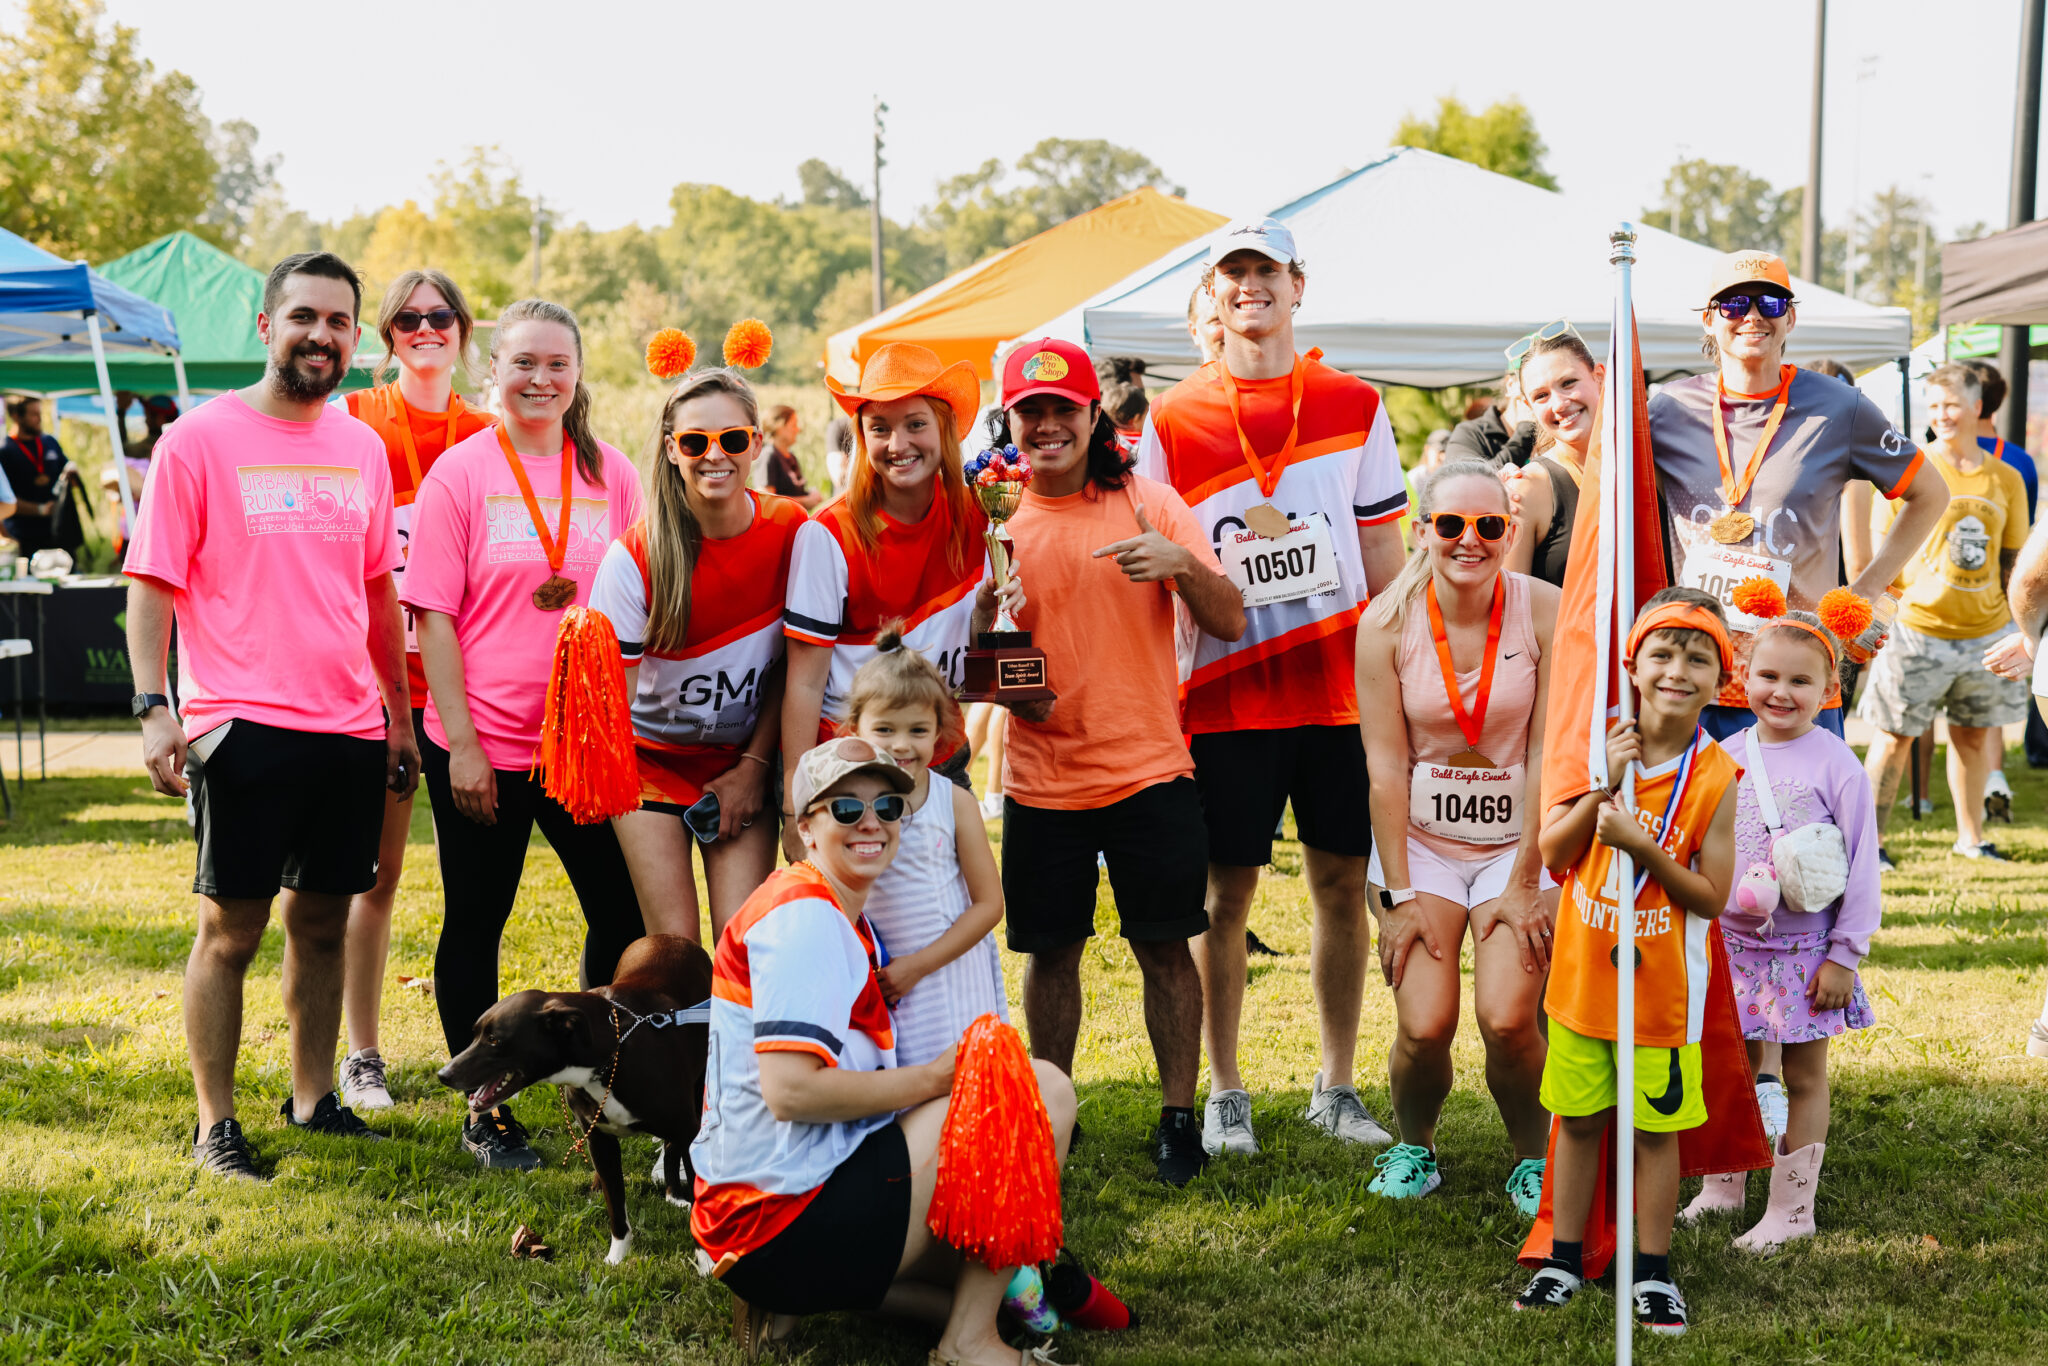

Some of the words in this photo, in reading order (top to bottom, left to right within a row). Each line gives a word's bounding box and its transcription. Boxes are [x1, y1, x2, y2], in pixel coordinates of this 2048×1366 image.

[1735, 258, 1768, 270] GMC
[1041, 352, 1060, 362] Bass
[1042, 360, 1057, 369] Pro
[1041, 368, 1065, 378] Shops
[240, 472, 299, 493] URBAN
[310, 474, 368, 521] 5K
[242, 491, 314, 512] RUNOFF
[487, 503, 543, 522] URBA
[248, 522, 304, 533] THROUGH
[309, 522, 368, 531] NASHVILLE
[488, 519, 560, 542] RUNOF
[322, 534, 337, 543] July
[1234, 531, 1257, 543] Bald
[567, 563, 583, 572] July
[1240, 543, 1316, 586] 10507
[1722, 552, 1747, 569] Eagle
[1746, 557, 1775, 572] Events
[1697, 572, 1739, 607] 105
[1431, 767, 1453, 779] Bald
[1454, 770, 1480, 784] Eagle
[1482, 770, 1512, 781] Events
[1431, 793, 1512, 824] 10469
